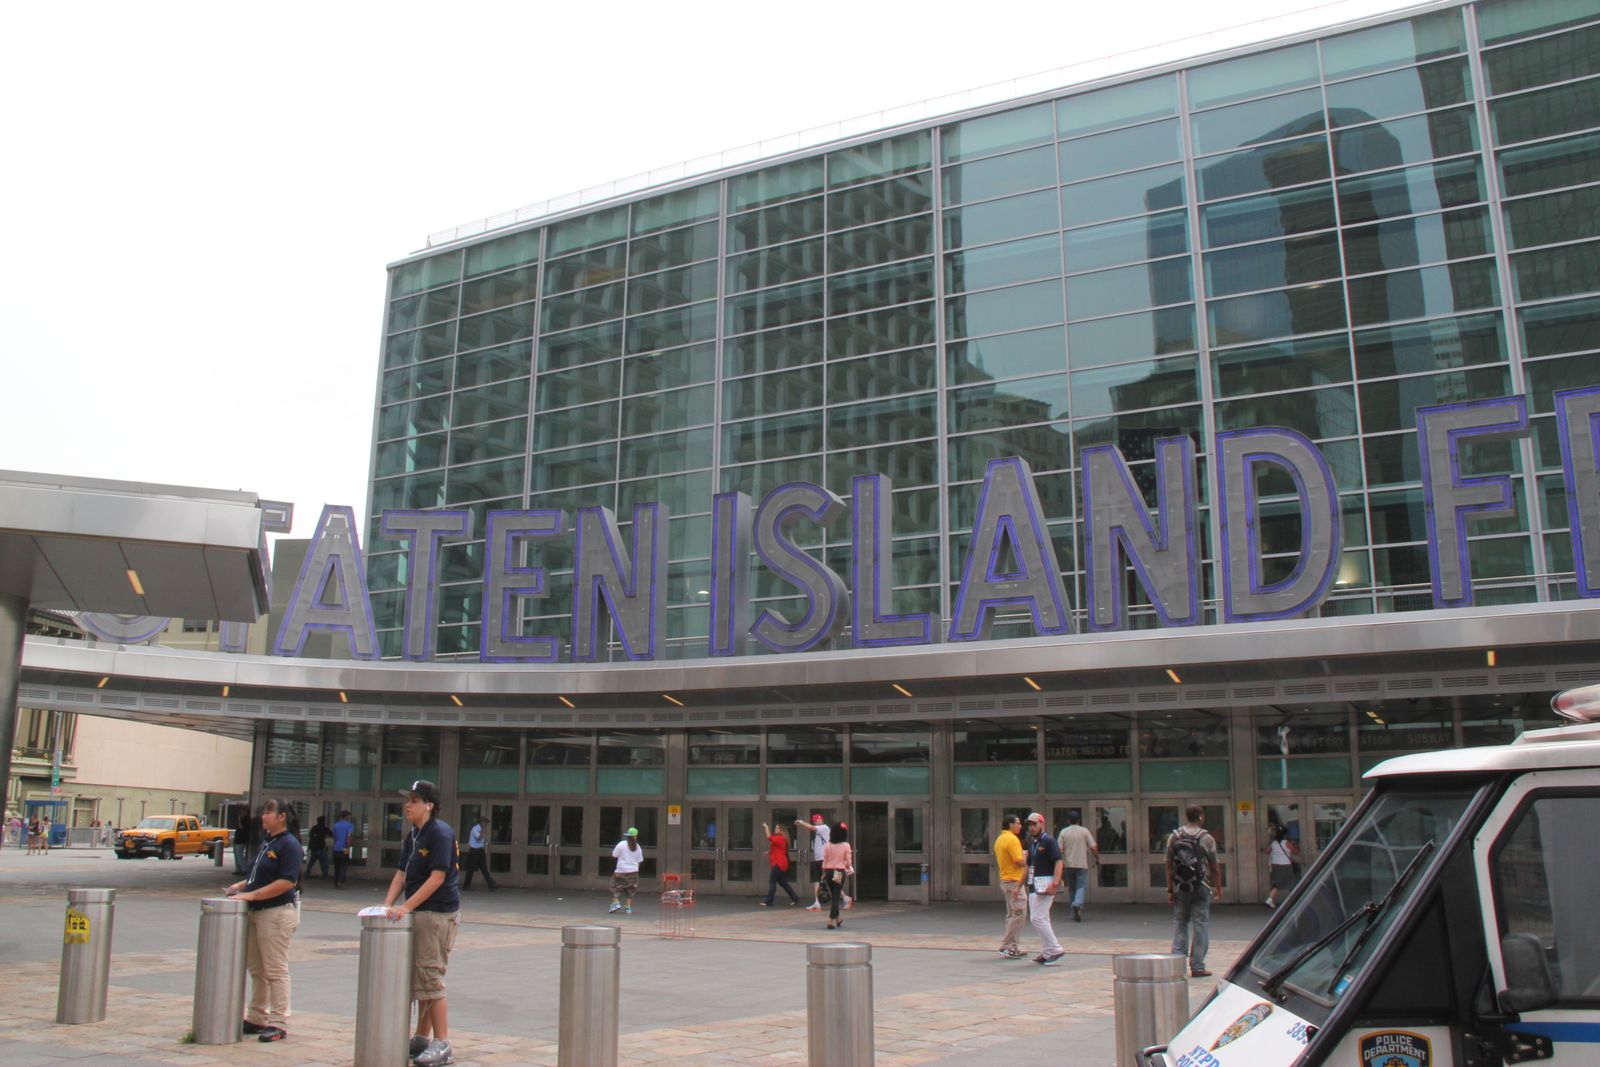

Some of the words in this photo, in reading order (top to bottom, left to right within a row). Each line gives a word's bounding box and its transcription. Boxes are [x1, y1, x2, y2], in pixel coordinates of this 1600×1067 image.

[76, 499, 670, 663] ATEN
[708, 425, 1345, 657] ISLAND
[1407, 732, 1450, 744] SUBWAY
[1375, 1033, 1413, 1046] POLICE
[1188, 1044, 1221, 1067] NYPD
[1363, 1042, 1427, 1061] DEPARTMENT
